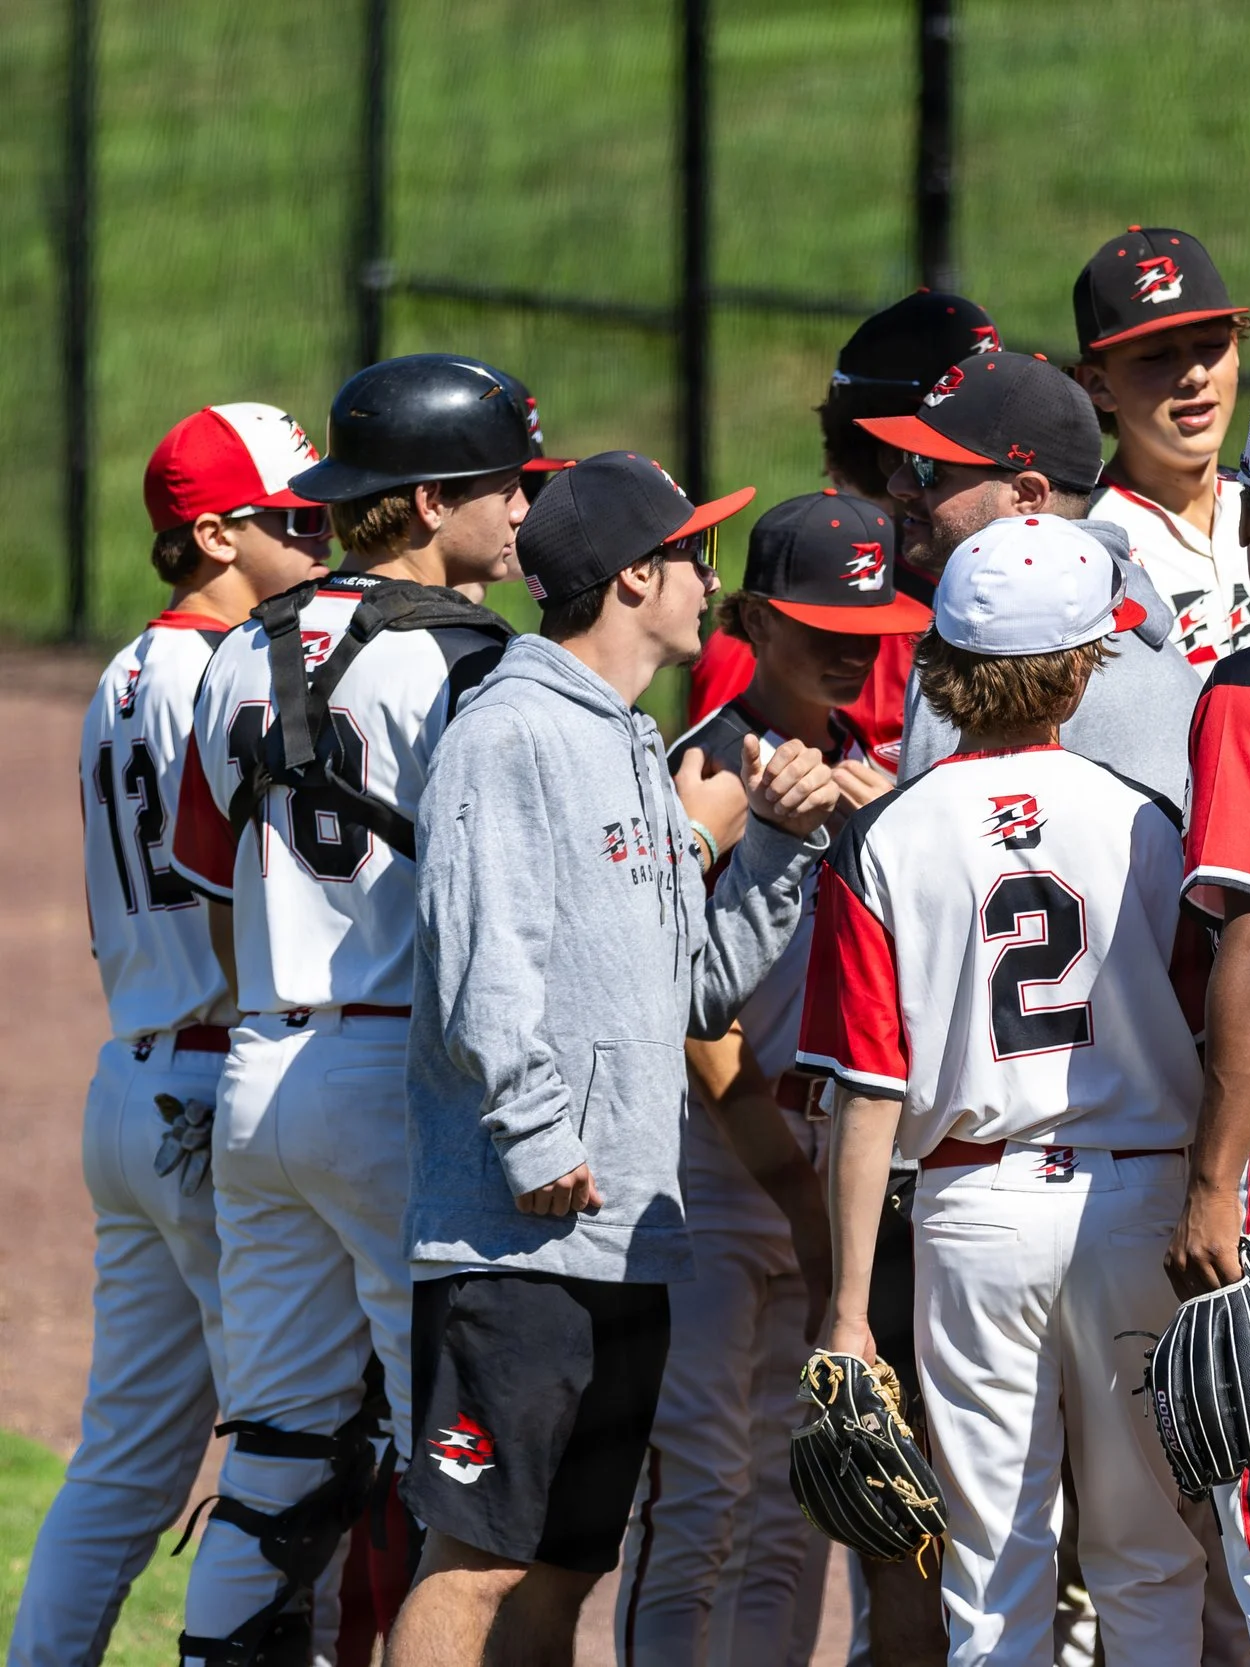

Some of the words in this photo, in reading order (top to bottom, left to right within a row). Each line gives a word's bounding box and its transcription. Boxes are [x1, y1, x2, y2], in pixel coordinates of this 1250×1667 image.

[330, 576, 359, 586] NIKE
[355, 577, 382, 588] PR
[92, 737, 201, 916] 12
[978, 869, 1096, 1063] 2
[1157, 1389, 1183, 1454] A2000
